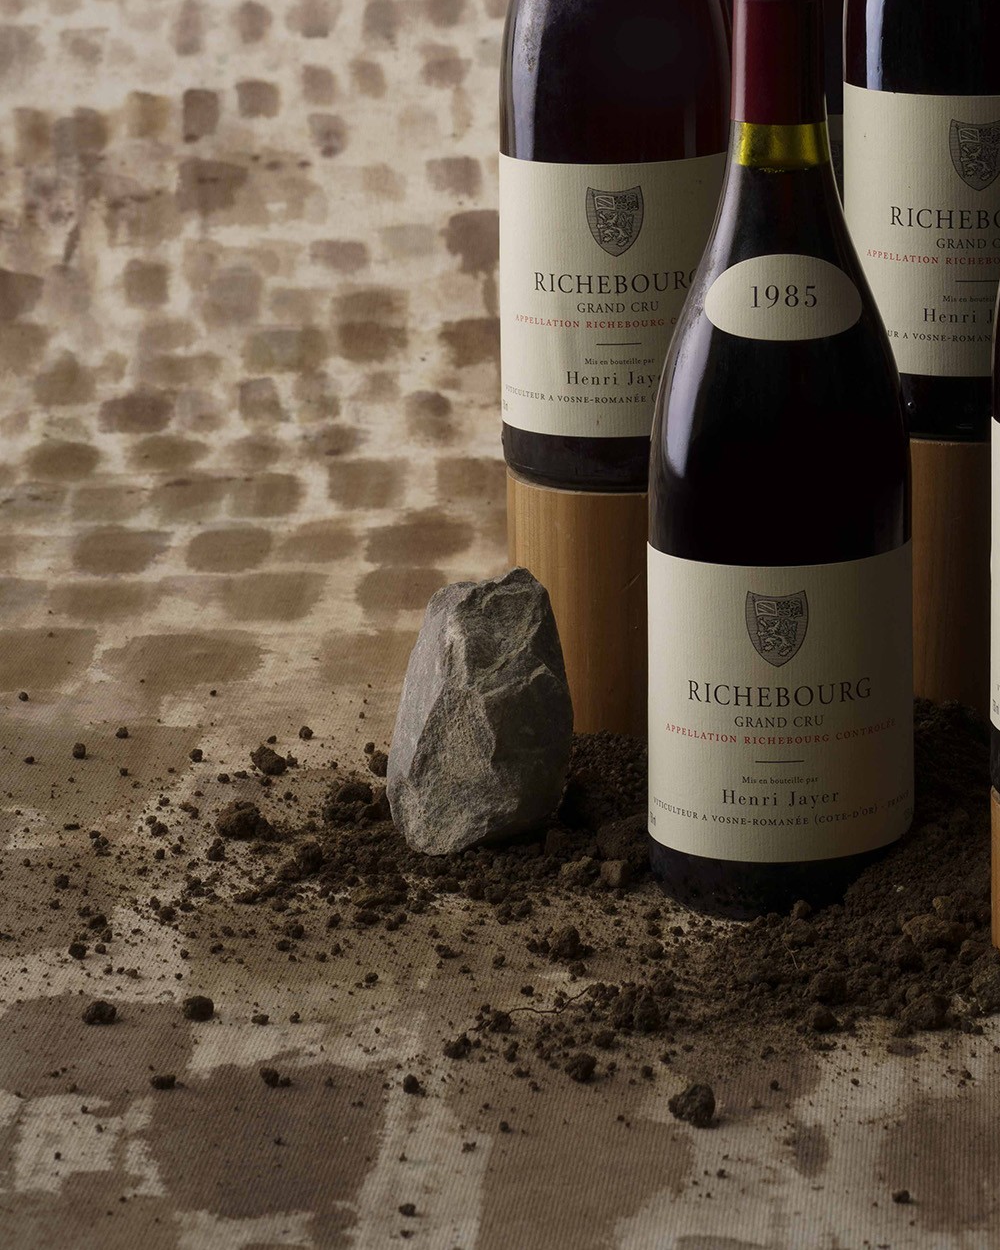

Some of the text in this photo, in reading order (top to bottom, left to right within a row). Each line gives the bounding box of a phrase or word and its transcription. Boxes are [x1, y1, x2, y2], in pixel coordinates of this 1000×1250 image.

[936, 238, 987, 250] GRAND
[866, 249, 1000, 265] APPELLATION RICHEBO
[750, 284, 818, 309] 1985
[576, 301, 659, 313] GRAND CRU
[515, 314, 580, 328] APPELLATION
[586, 318, 665, 329] RICHEBOURG
[923, 308, 977, 323] Henri
[912, 332, 991, 343] VOSNE-ROMAN
[584, 357, 598, 365] Mis
[610, 357, 642, 365] bouteille
[566, 370, 661, 388] Henri Jay
[557, 393, 647, 404] VOSNE-ROMANÉE
[687, 677, 872, 708] RICHEBOURG
[734, 714, 824, 729] GRAND CRU
[665, 723, 737, 743] APPELLATION
[744, 733, 830, 745] RICHEBOURG
[742, 775, 757, 784] Mis
[770, 776, 804, 785] bouteille
[806, 777, 819, 786] par
[722, 789, 840, 809] Henri Jayer
[711, 814, 809, 827] VOSNE-ROMANÉE
